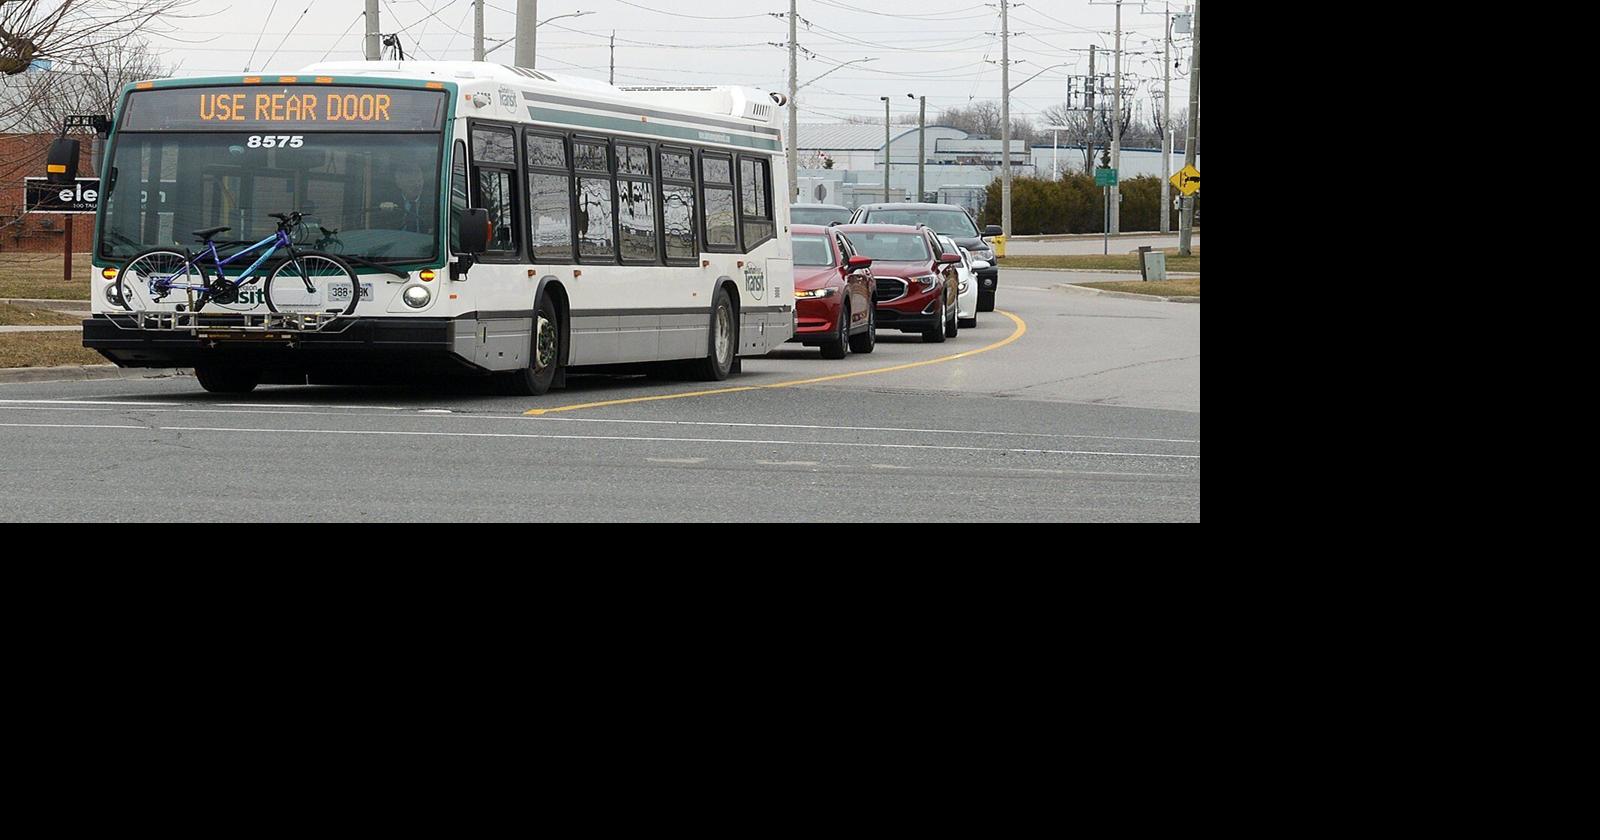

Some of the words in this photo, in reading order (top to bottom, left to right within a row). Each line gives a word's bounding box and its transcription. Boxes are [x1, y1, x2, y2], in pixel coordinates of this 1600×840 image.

[200, 94, 246, 121] USE
[255, 94, 318, 121] REAR
[326, 94, 391, 121] DOOR
[246, 135, 304, 149] 8575
